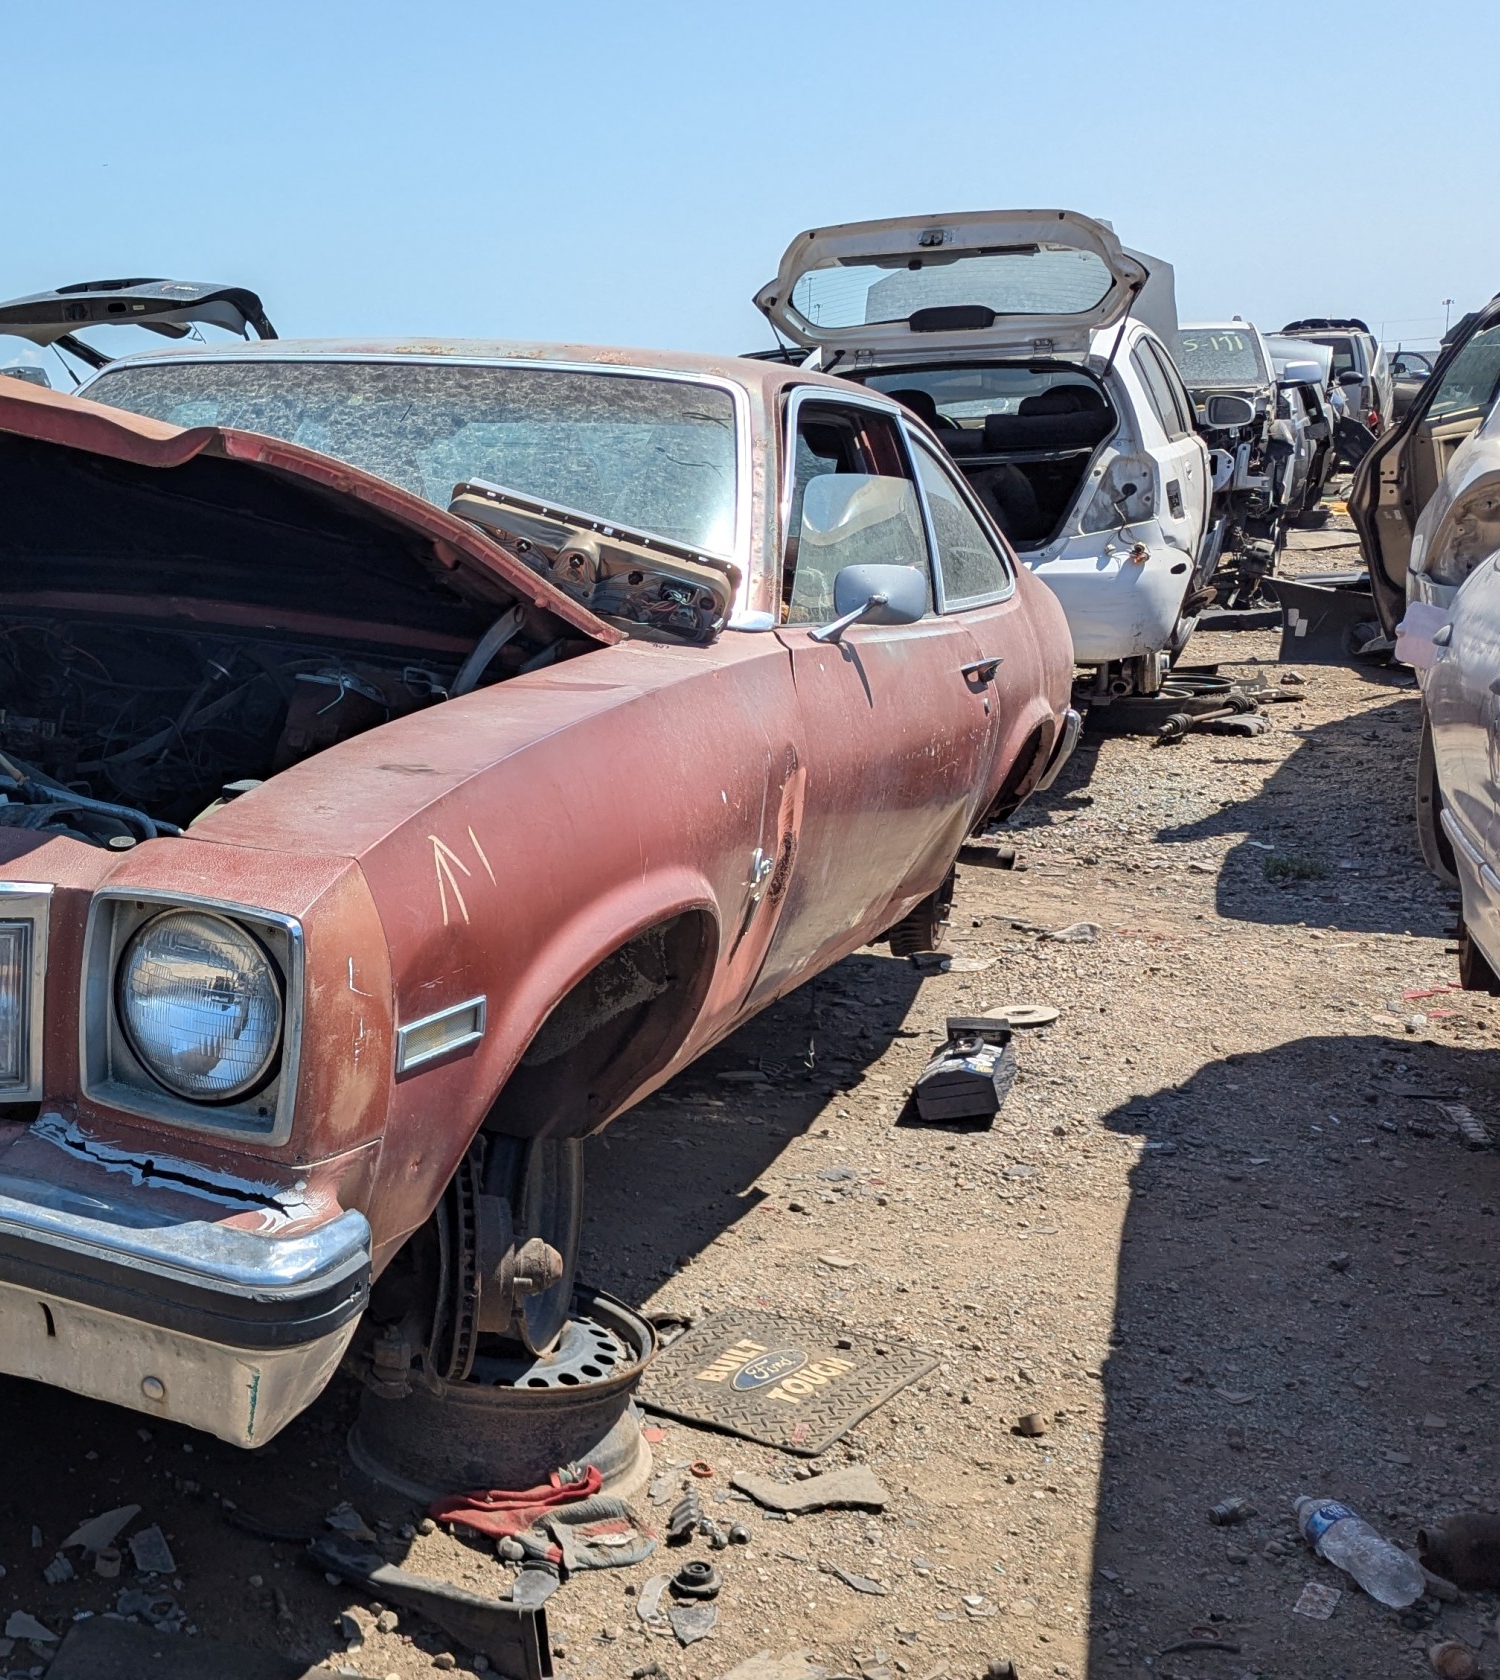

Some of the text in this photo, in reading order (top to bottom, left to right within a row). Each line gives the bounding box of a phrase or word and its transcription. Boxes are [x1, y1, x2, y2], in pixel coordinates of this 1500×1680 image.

[694, 1338, 768, 1383] BUILT
[744, 1355, 796, 1380] Ford
[765, 1356, 858, 1405] TOUGH
